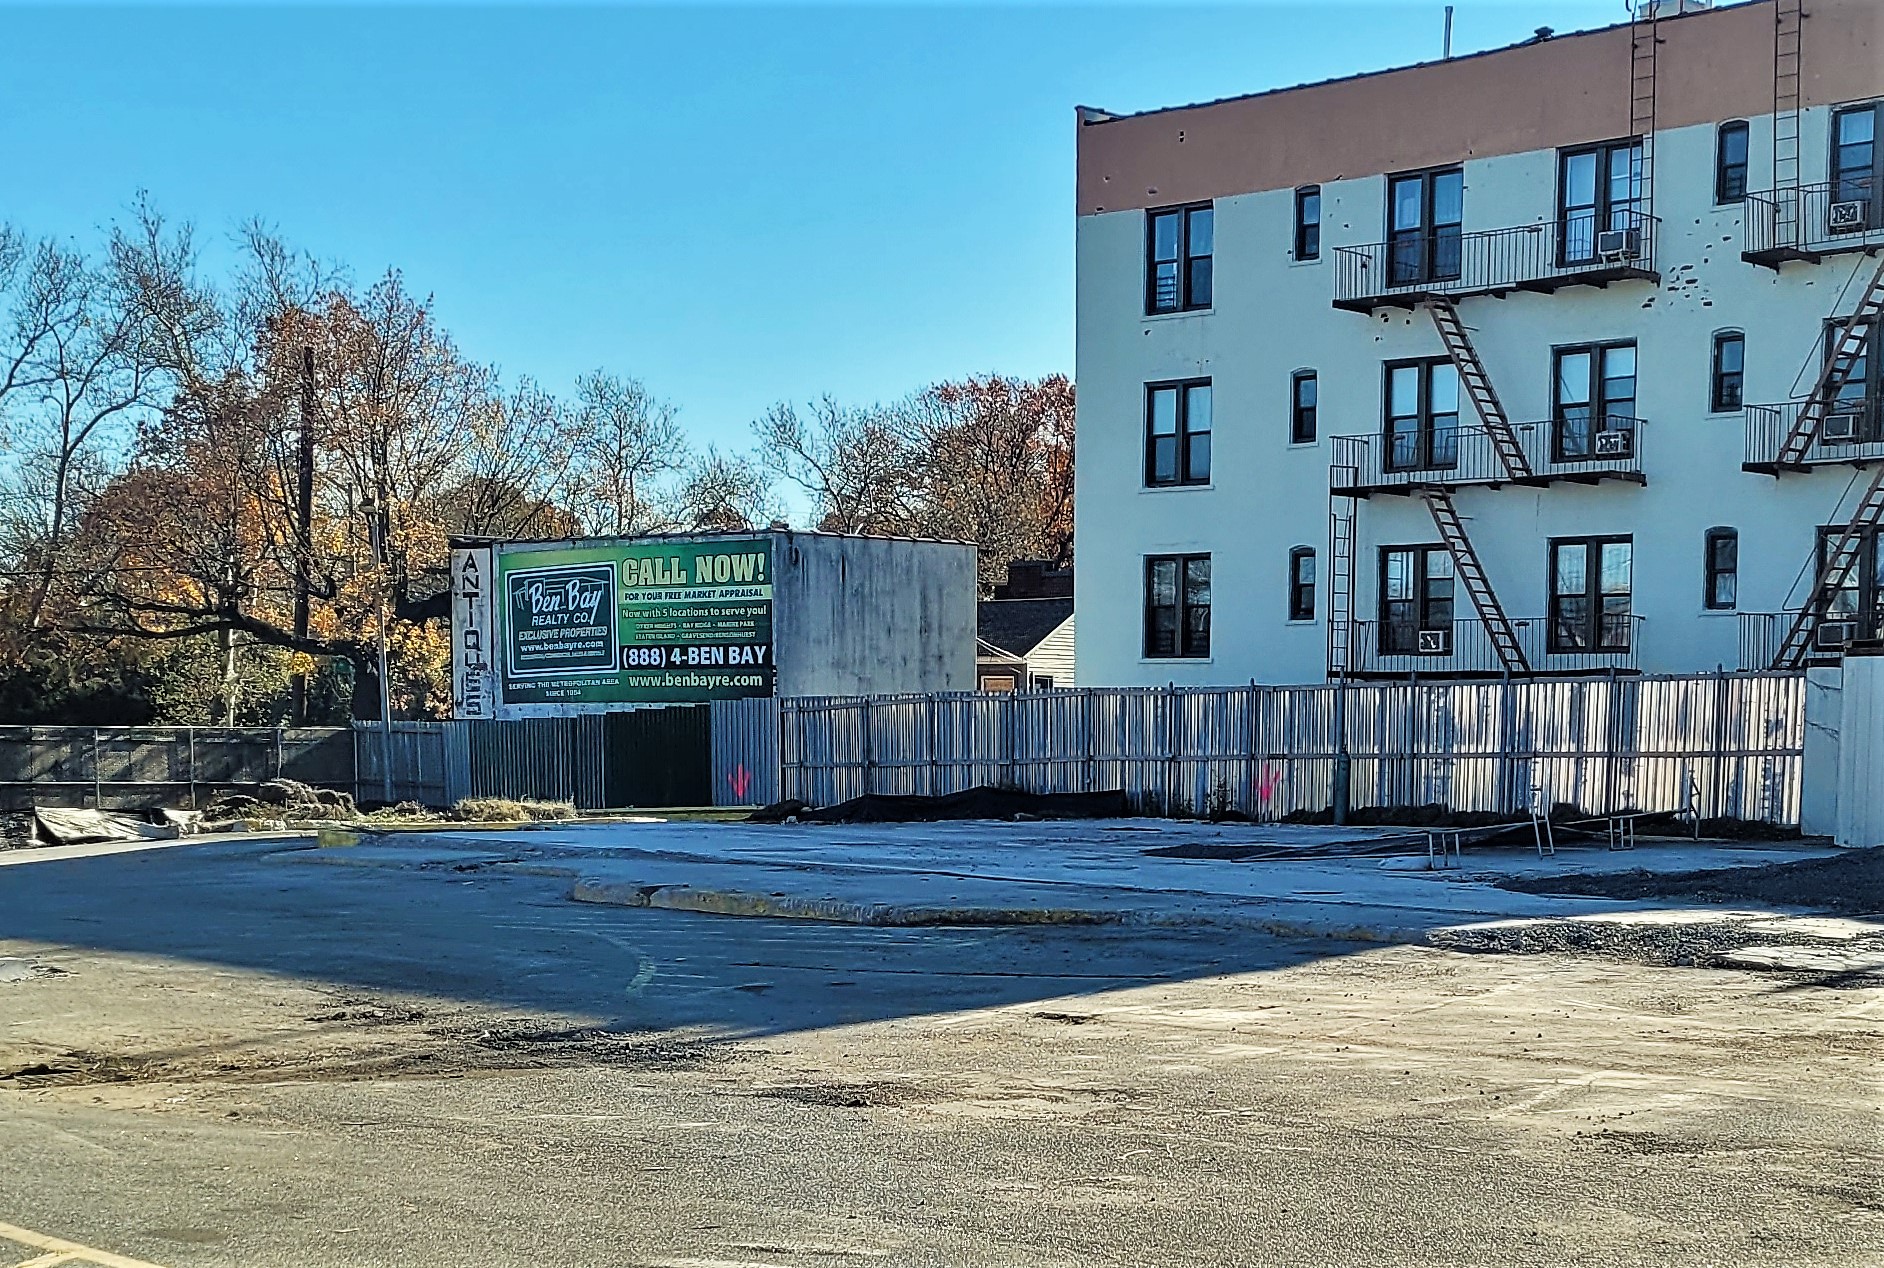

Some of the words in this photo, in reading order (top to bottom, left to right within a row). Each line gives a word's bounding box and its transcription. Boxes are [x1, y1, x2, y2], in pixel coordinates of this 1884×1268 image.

[622, 557, 687, 587] CALL
[695, 552, 765, 584] NOW!
[624, 592, 640, 601] FOR
[641, 591, 663, 601] YOUR
[664, 591, 682, 600] FREE
[684, 589, 717, 599] MARKET
[718, 588, 764, 598] APPRAISAL
[622, 608, 641, 618] Now
[642, 607, 661, 618] with
[662, 608, 668, 617] 5
[669, 605, 709, 617] locations
[710, 606, 720, 616] to
[721, 607, 746, 616] serve
[746, 604, 767, 618] you!
[532, 613, 570, 627] REALTY
[573, 612, 591, 623] CO.
[461, 551, 482, 716] ANTIQUES
[518, 628, 560, 641] EXCLUSIVE
[559, 626, 608, 639] PROPERTIES
[520, 640, 604, 652] www.benbayre.com
[623, 646, 667, 668] (888)
[670, 646, 724, 665] 4-BEN
[728, 645, 767, 665] BAY
[628, 672, 763, 690] www.benbayre.com
